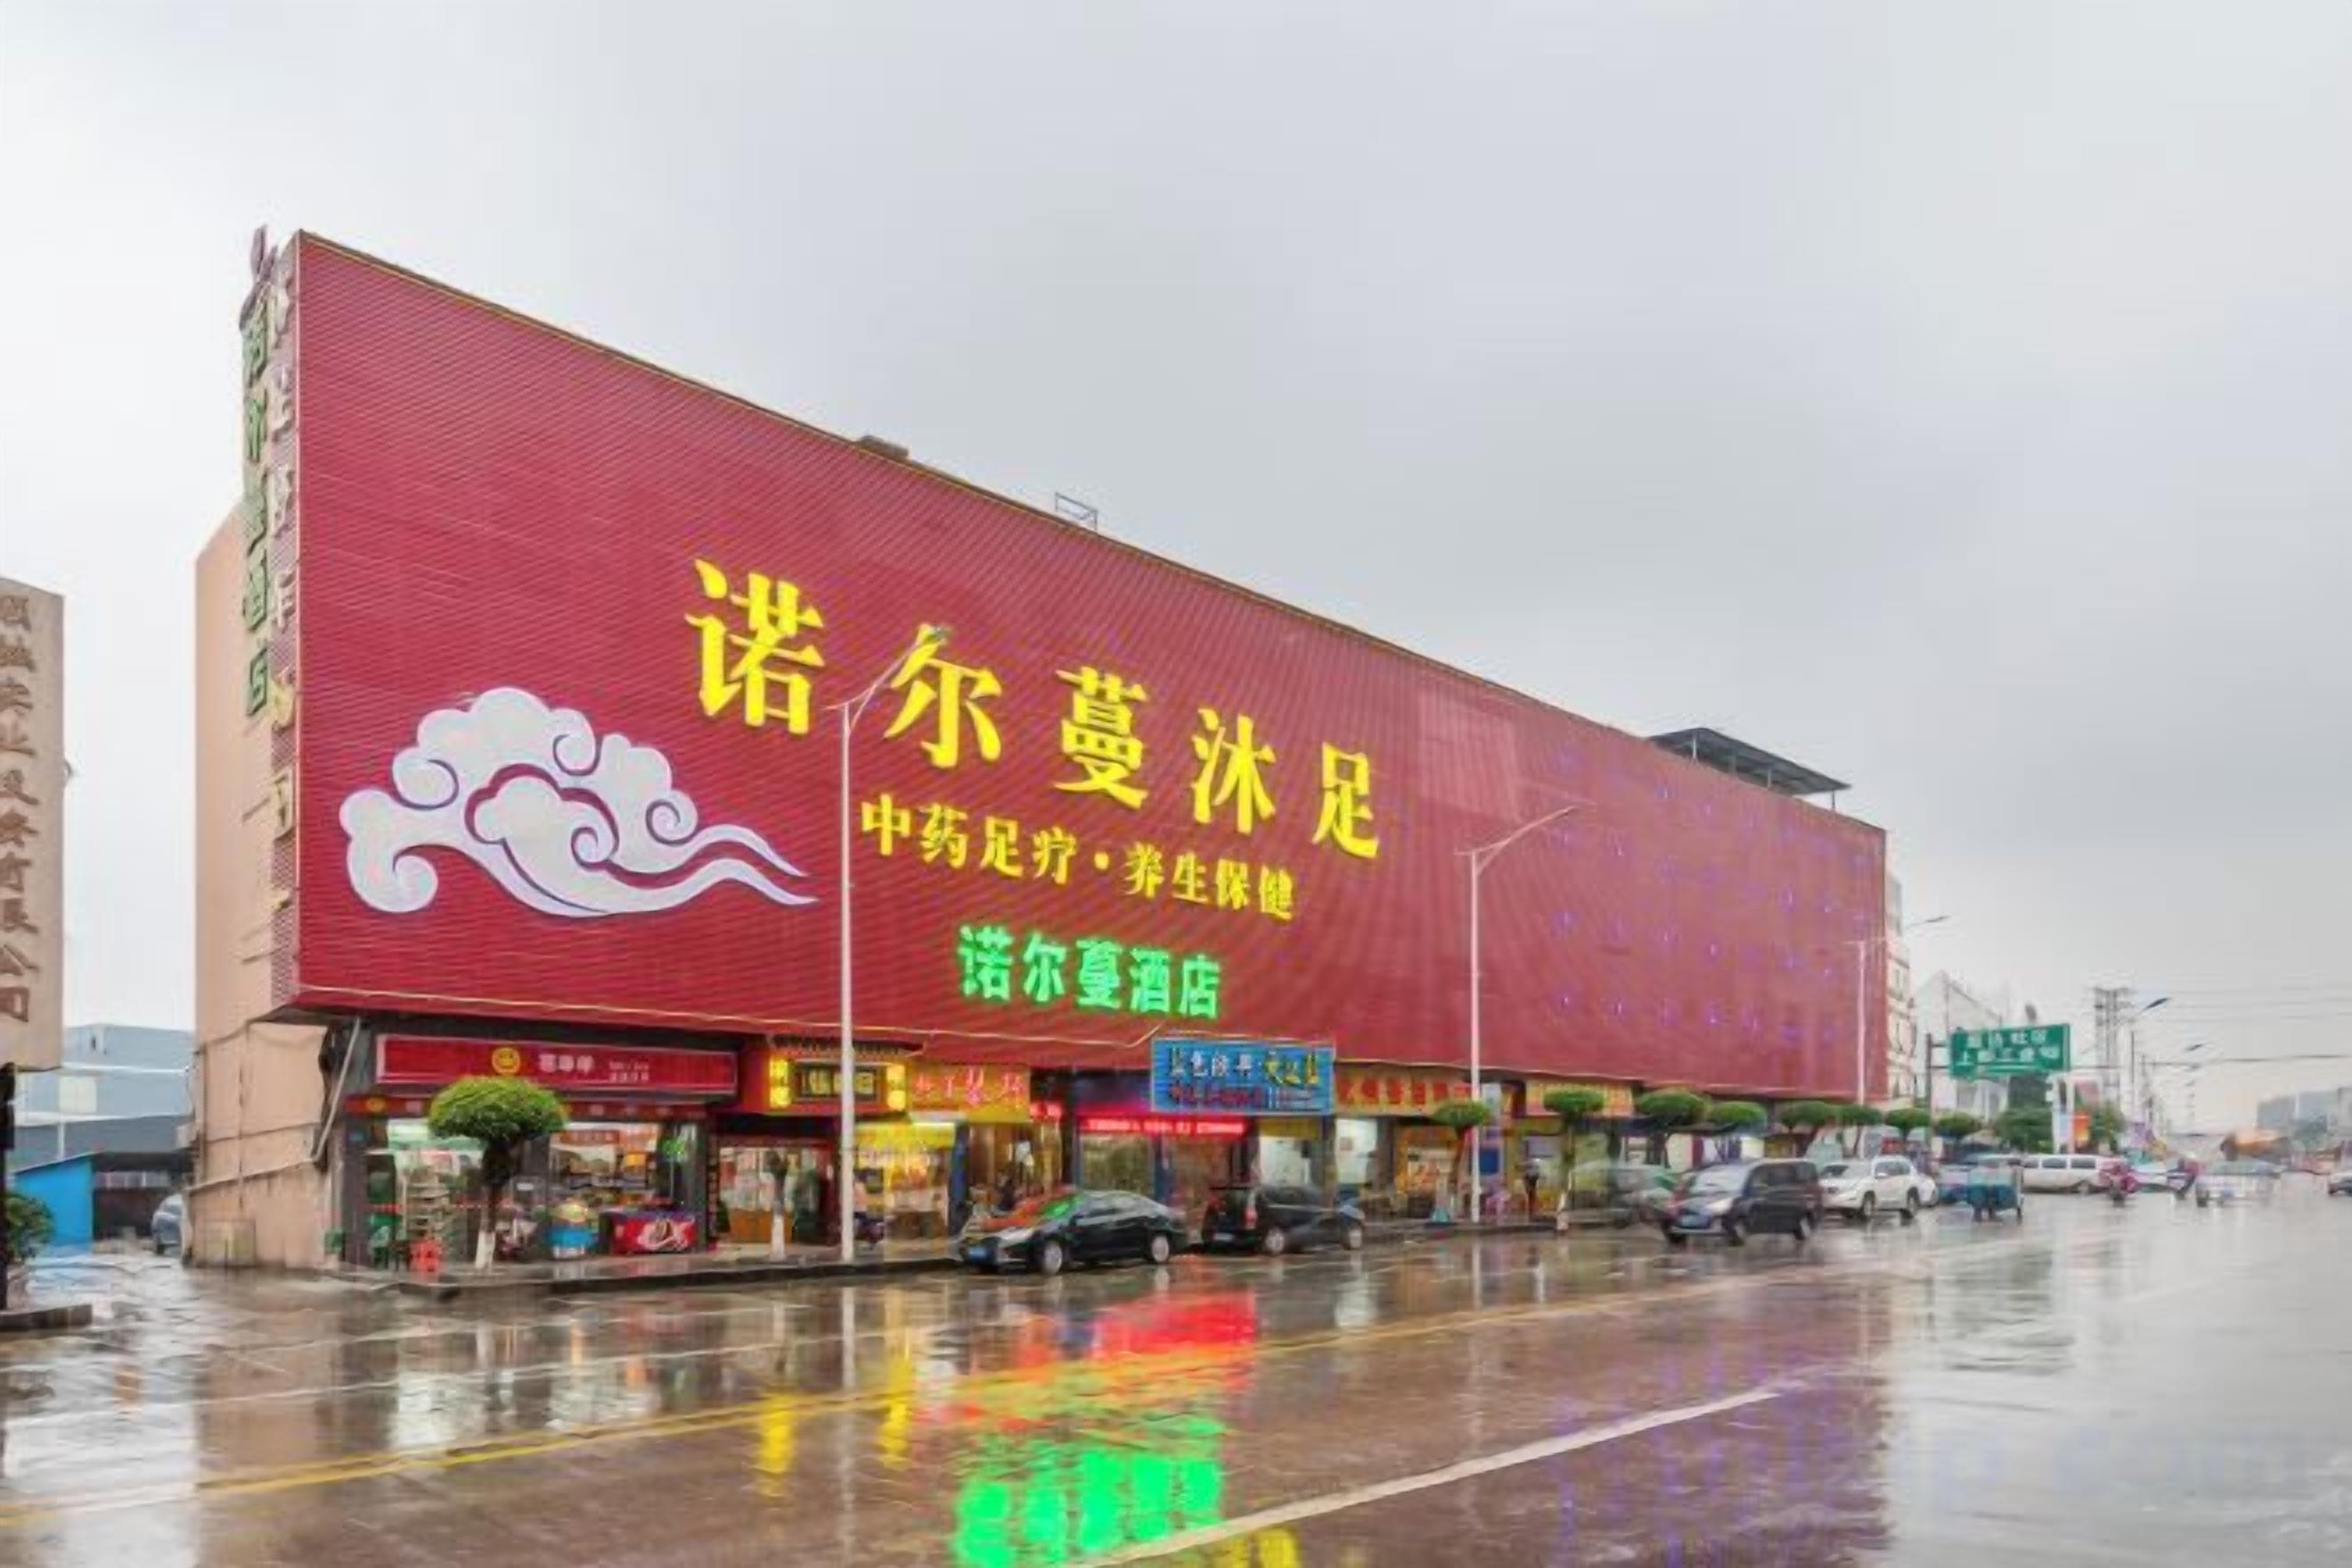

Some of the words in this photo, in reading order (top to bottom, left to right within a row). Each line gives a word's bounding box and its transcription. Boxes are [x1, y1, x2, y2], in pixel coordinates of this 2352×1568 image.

[685, 559, 1379, 859] 诺尔蔓沐足
[861, 793, 1294, 920] 中药足疗·养生保健
[957, 923, 1221, 1019] 诺尔蔓酒店
